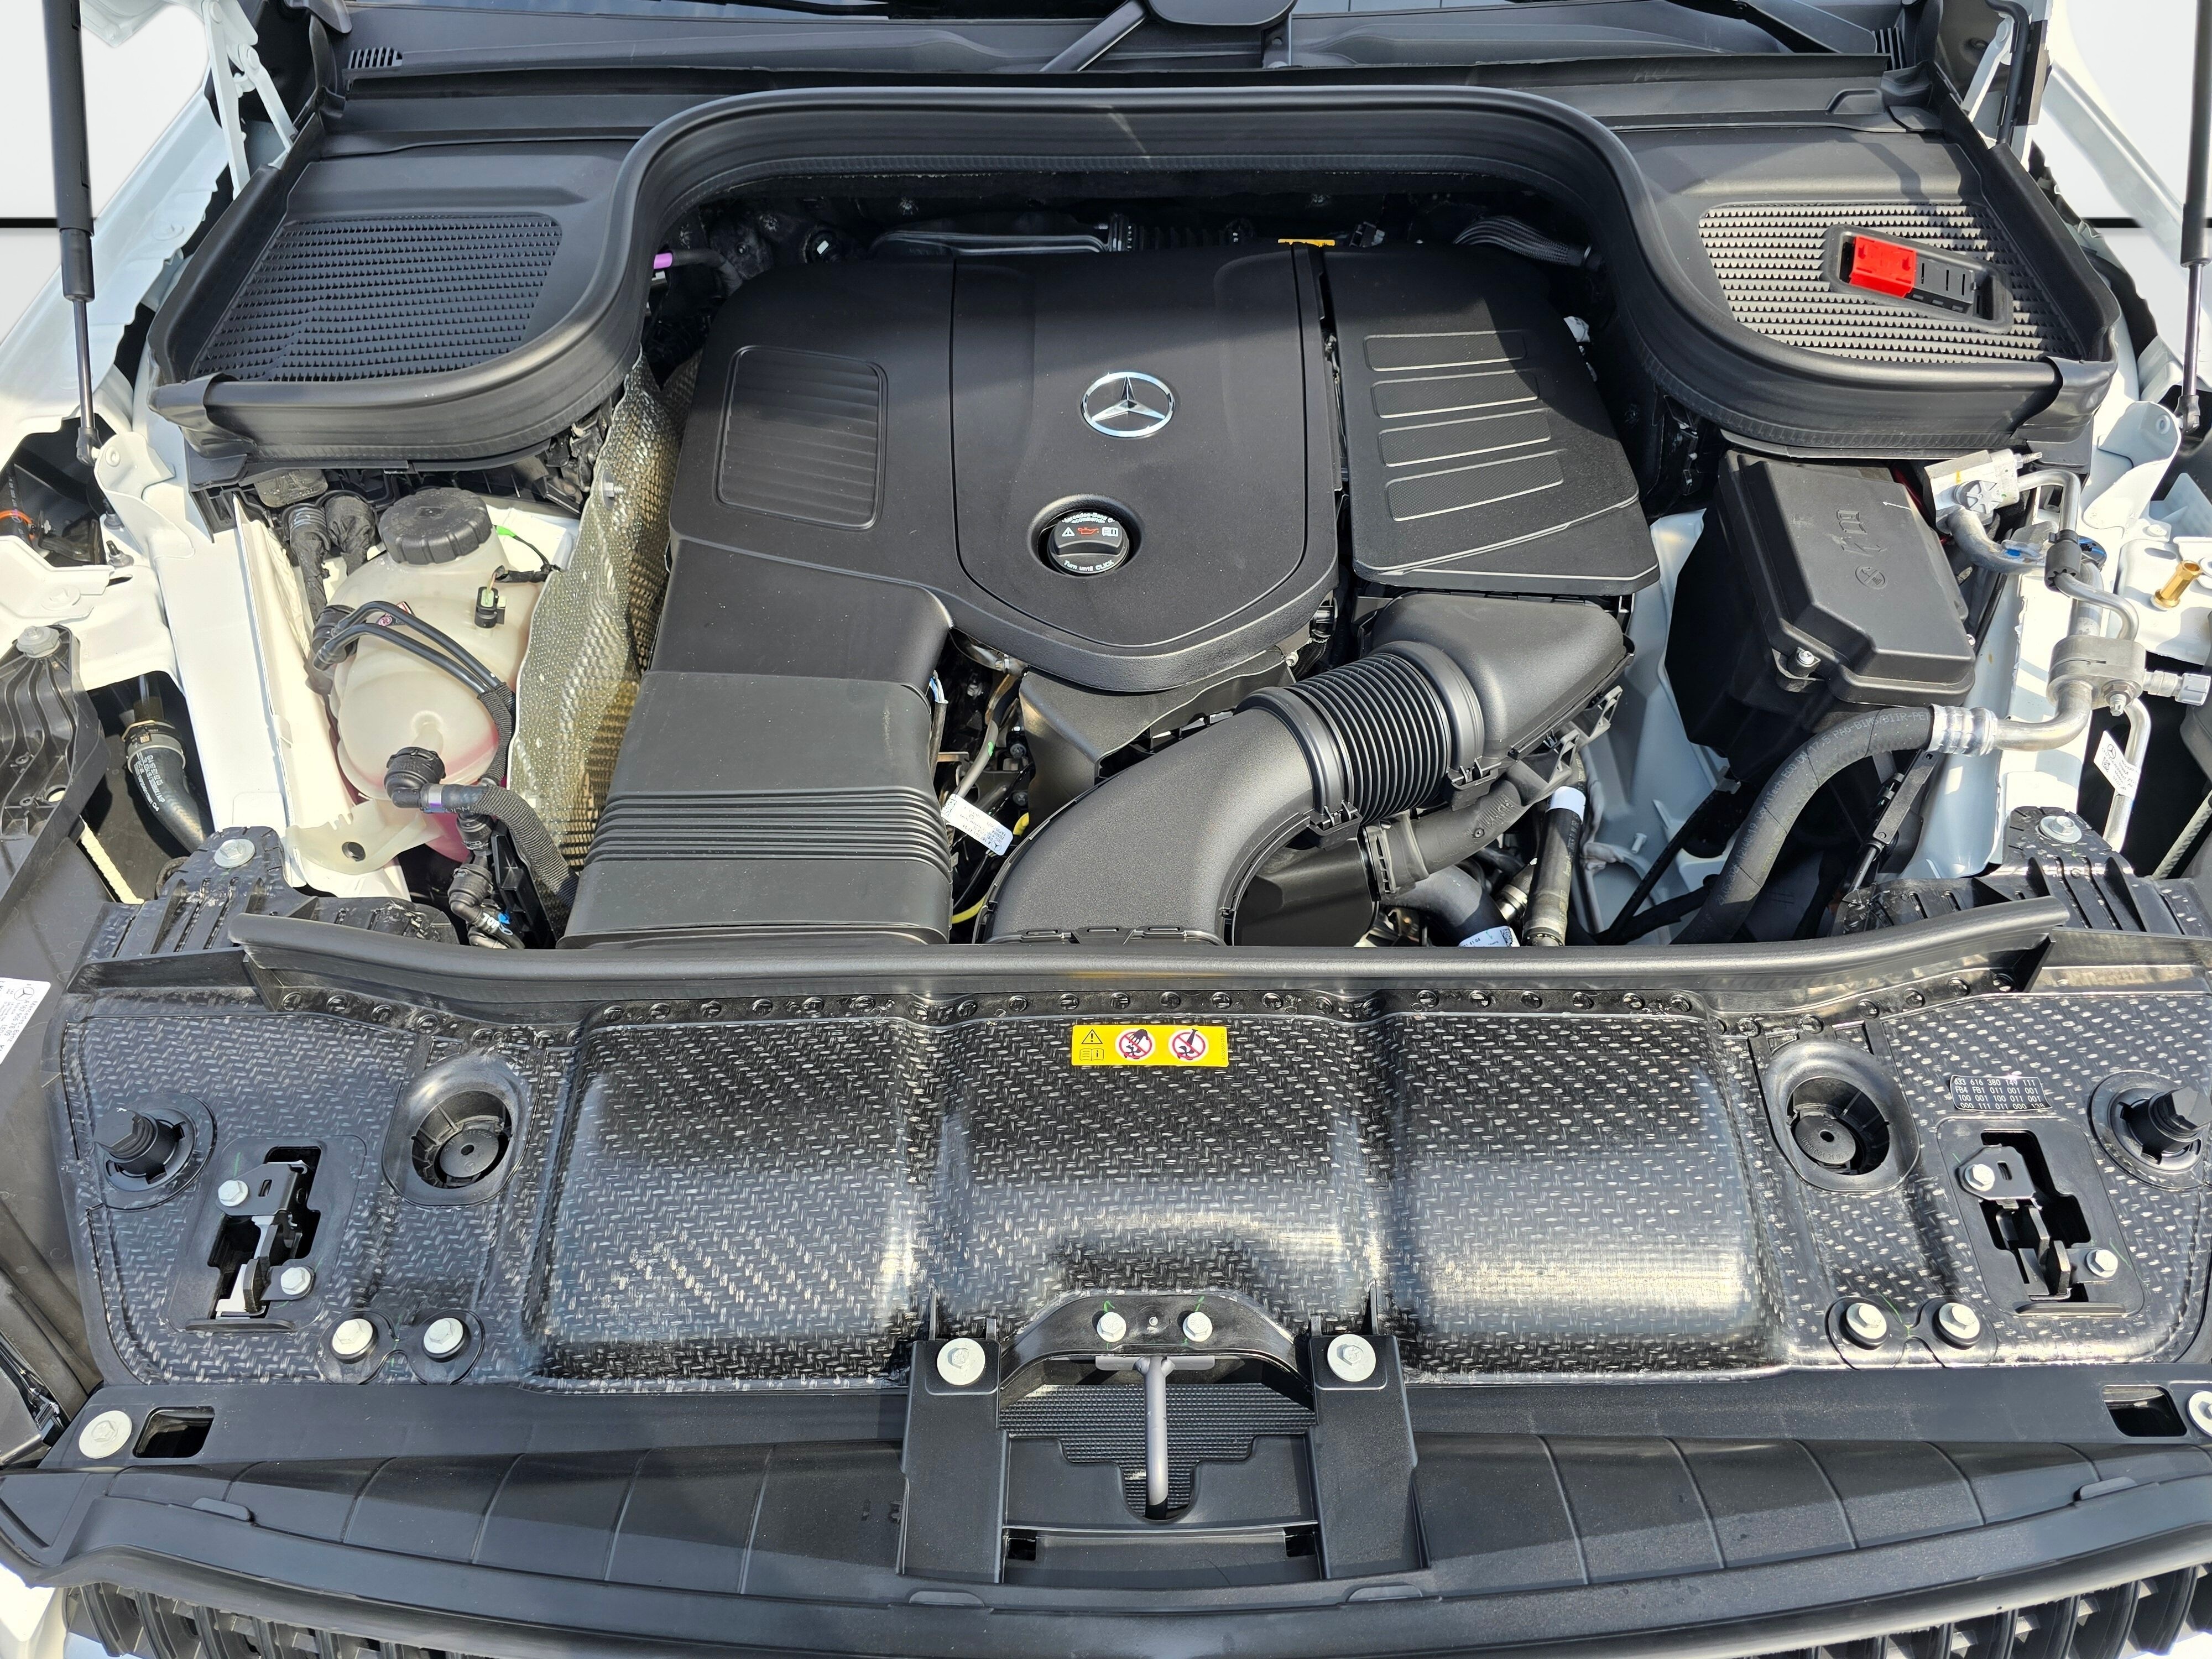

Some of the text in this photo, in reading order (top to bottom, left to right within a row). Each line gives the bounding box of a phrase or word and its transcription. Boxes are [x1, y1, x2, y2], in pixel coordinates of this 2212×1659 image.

[1064, 560, 1078, 570] Turn
[1095, 559, 1115, 570] CLICK
[1781, 764, 1798, 779] ECO
[482, 912, 500, 929] TOP
[7, 1001, 38, 1042] Mercedes-Benz
